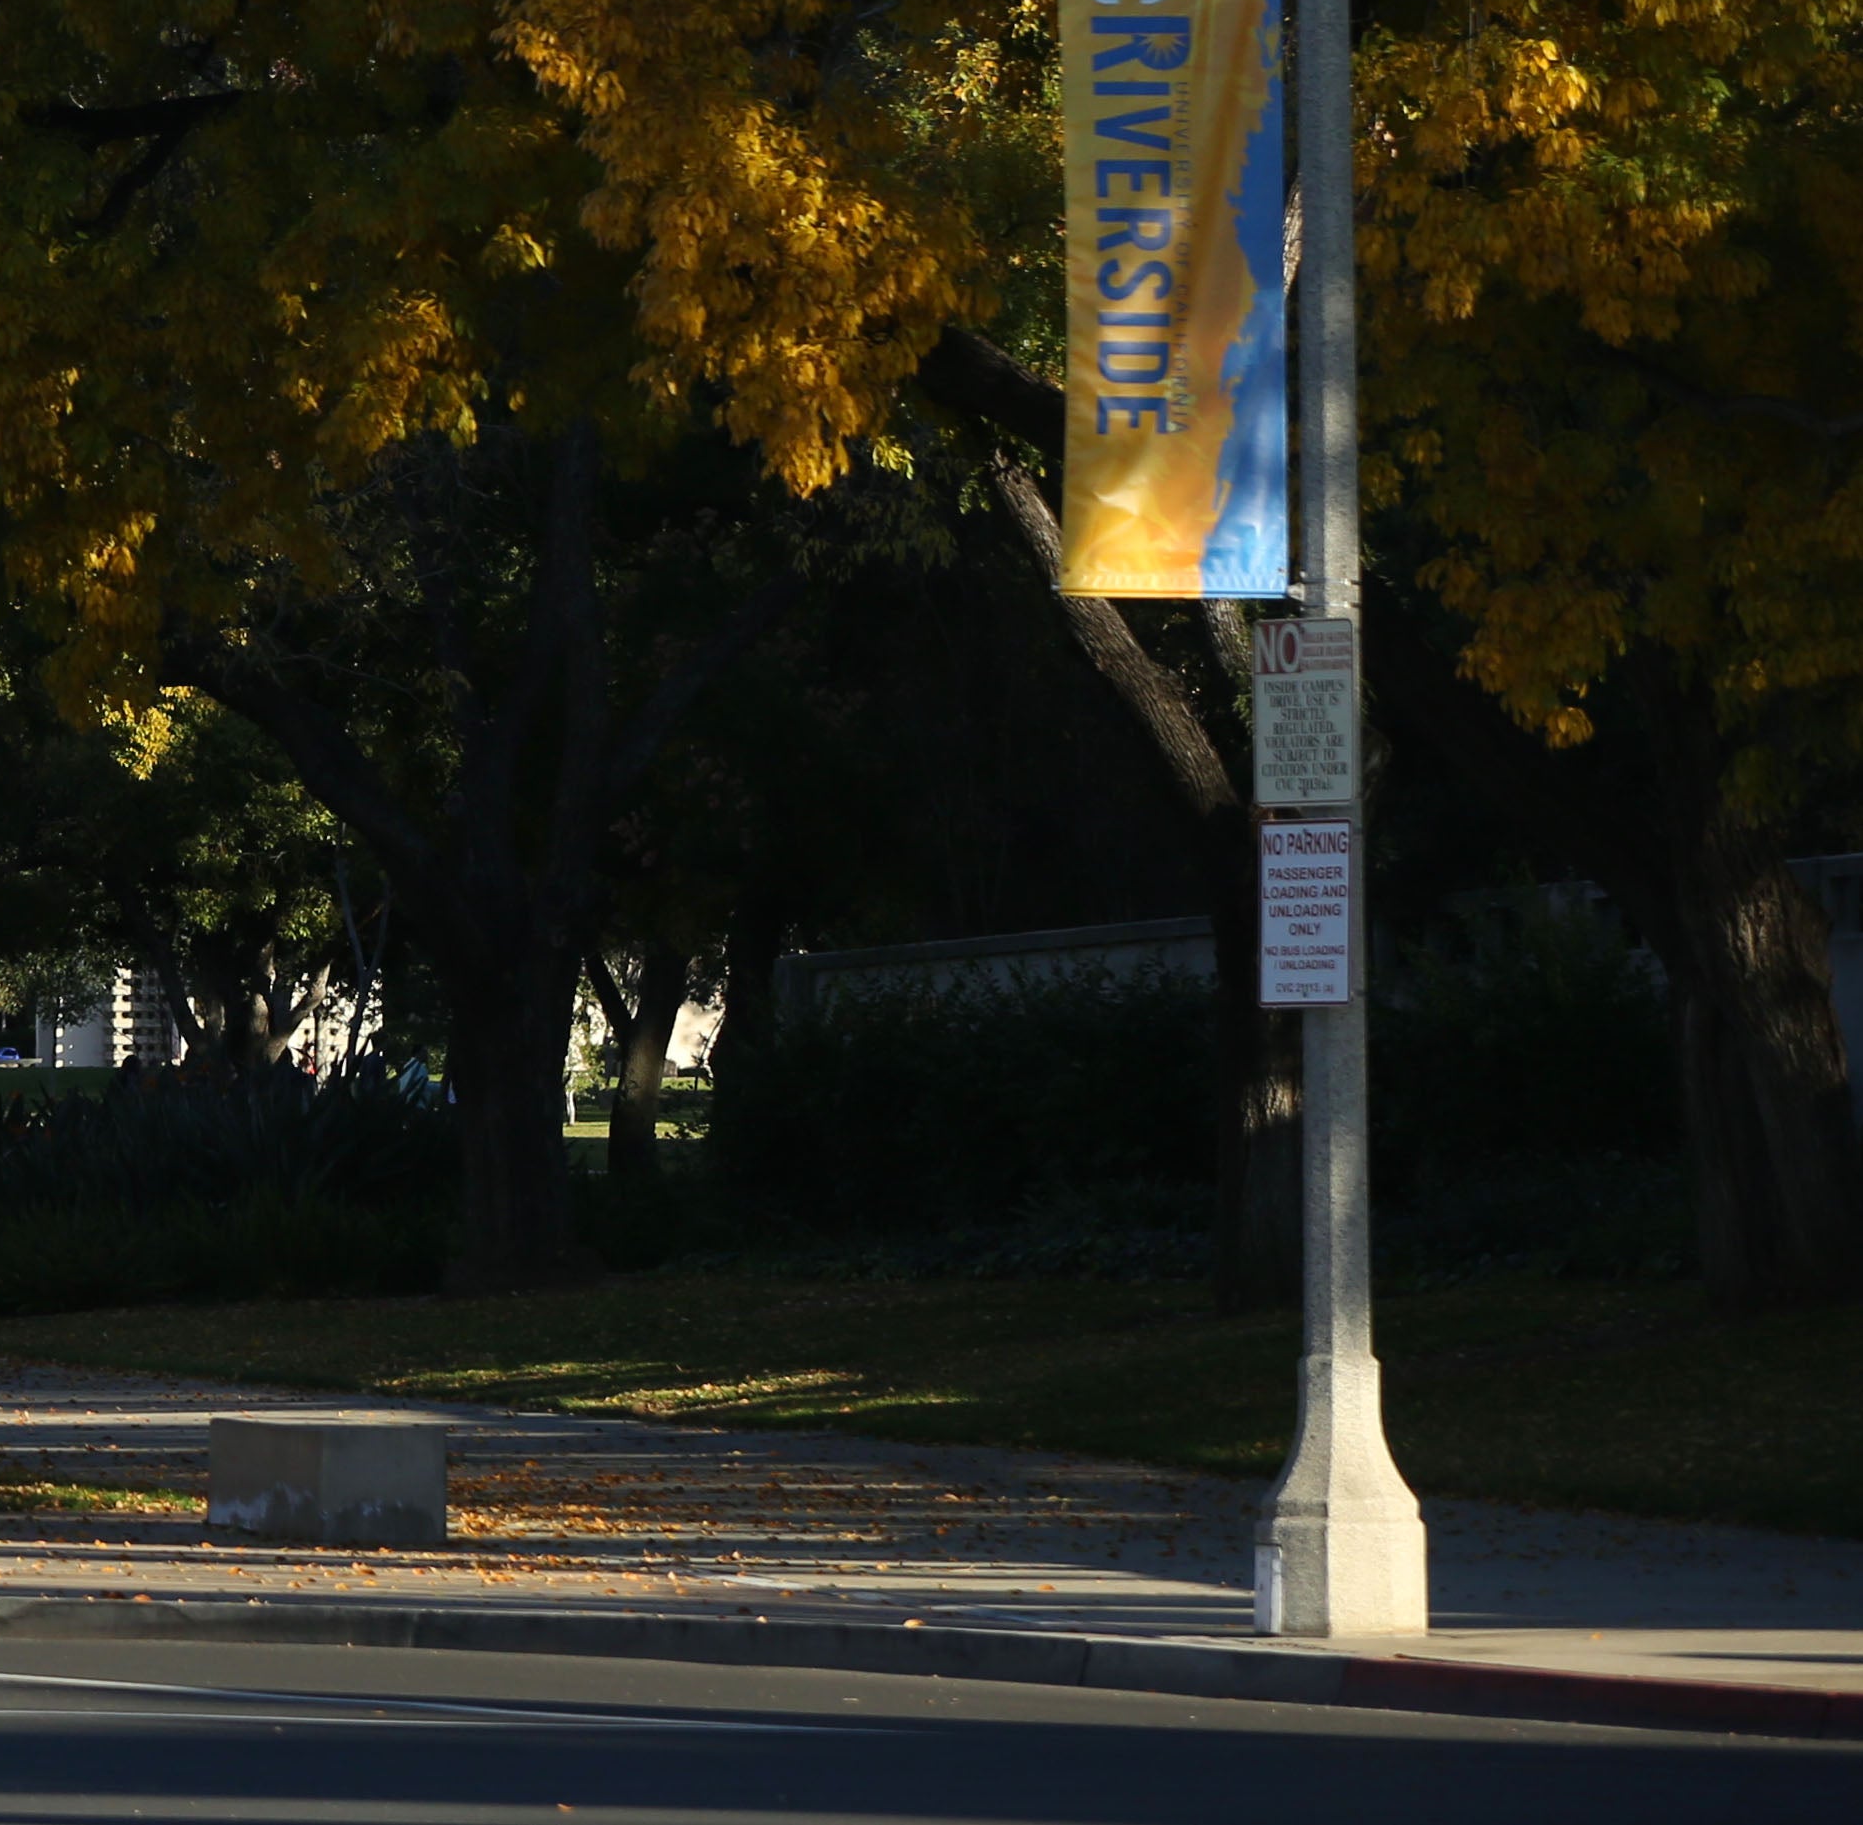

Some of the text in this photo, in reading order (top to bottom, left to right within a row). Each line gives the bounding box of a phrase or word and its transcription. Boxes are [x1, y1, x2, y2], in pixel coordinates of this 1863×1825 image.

[1091, 16, 1191, 434] RIVERSIDE
[1173, 81, 1191, 432] UNIVERSITY OF CALIFORNIA
[1255, 623, 1300, 673] NO
[1264, 679, 1345, 694] INSIDE CAMPUS
[1281, 707, 1327, 721] STRICTLY
[1265, 735, 1320, 748] VIOLATORS
[1261, 763, 1308, 776] CITATION
[1262, 831, 1348, 856] NO PARKING
[1268, 866, 1343, 880] PASSENGER
[1263, 884, 1347, 900] LOADING AND
[1269, 903, 1341, 918] UNLOADING
[1288, 922, 1321, 936] ONLY
[1264, 944, 1345, 956] NO BUS LOADING
[1279, 959, 1335, 970] UNLOADING
